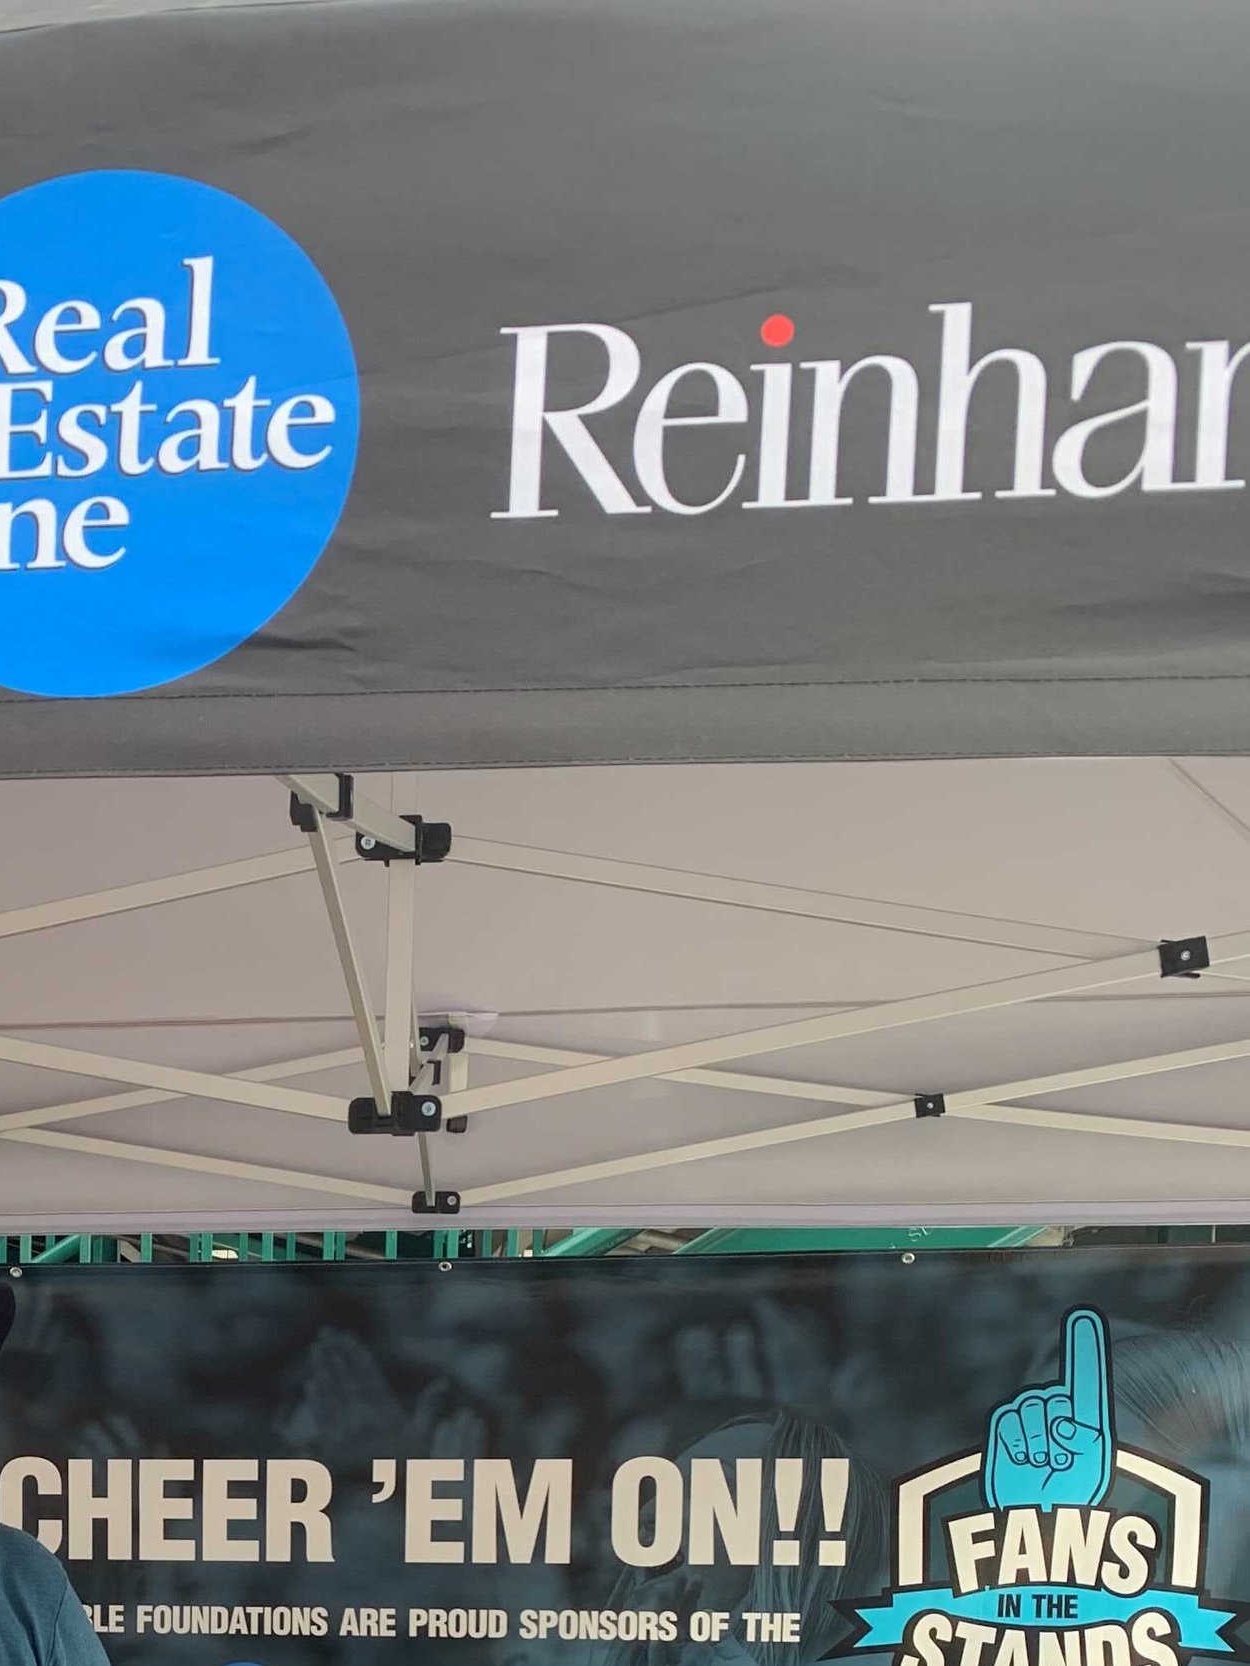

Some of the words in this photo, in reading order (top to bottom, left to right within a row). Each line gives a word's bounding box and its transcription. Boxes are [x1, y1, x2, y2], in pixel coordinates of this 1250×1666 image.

[0, 1456, 335, 1564] CHEER
[610, 1456, 853, 1568] ON!!
[948, 1506, 1157, 1596] FANS
[136, 1604, 329, 1640] FOUNDATIONS
[340, 1606, 397, 1640] ARE
[407, 1606, 508, 1641] PROUD
[519, 1608, 682, 1643] SPONSORS
[689, 1610, 730, 1644] OF
[742, 1611, 802, 1645] THE
[997, 1593, 1026, 1618] IN
[1031, 1593, 1079, 1619] THE
